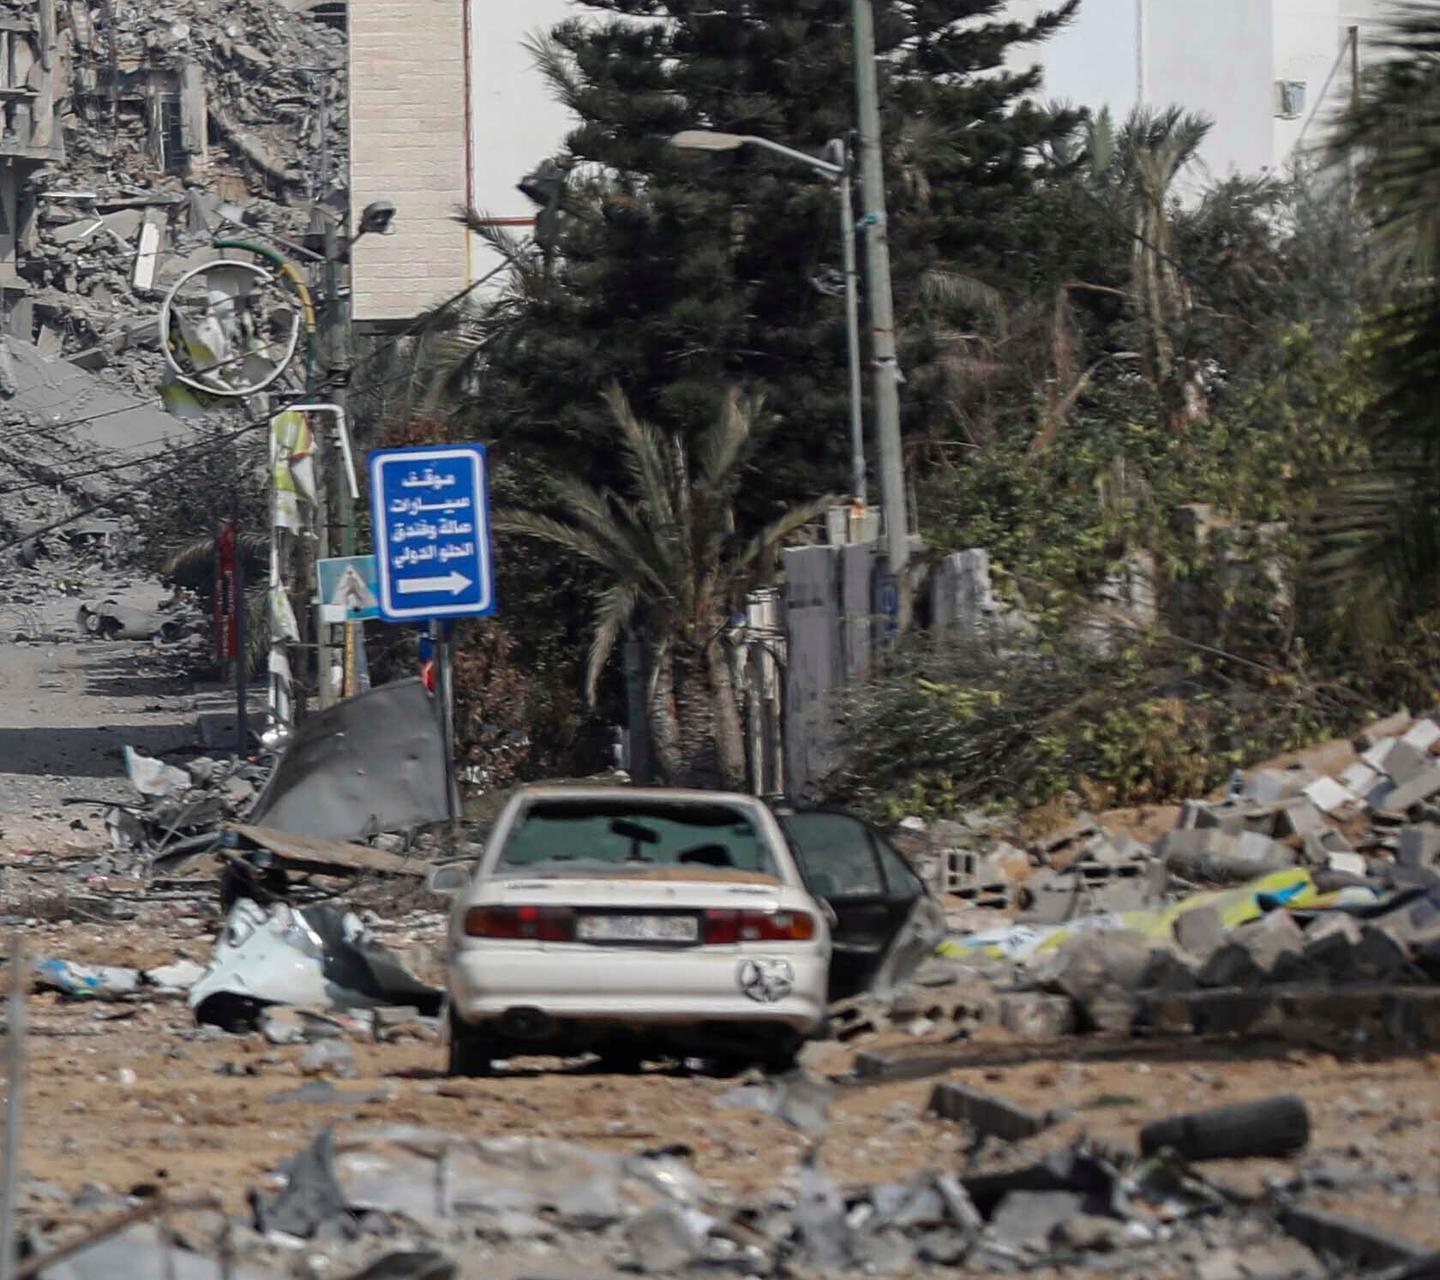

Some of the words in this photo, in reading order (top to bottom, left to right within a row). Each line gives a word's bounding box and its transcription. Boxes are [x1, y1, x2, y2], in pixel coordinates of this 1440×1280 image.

[401, 468, 455, 489] موقف
[389, 496, 470, 516] سيارات
[437, 518, 472, 535] صالة
